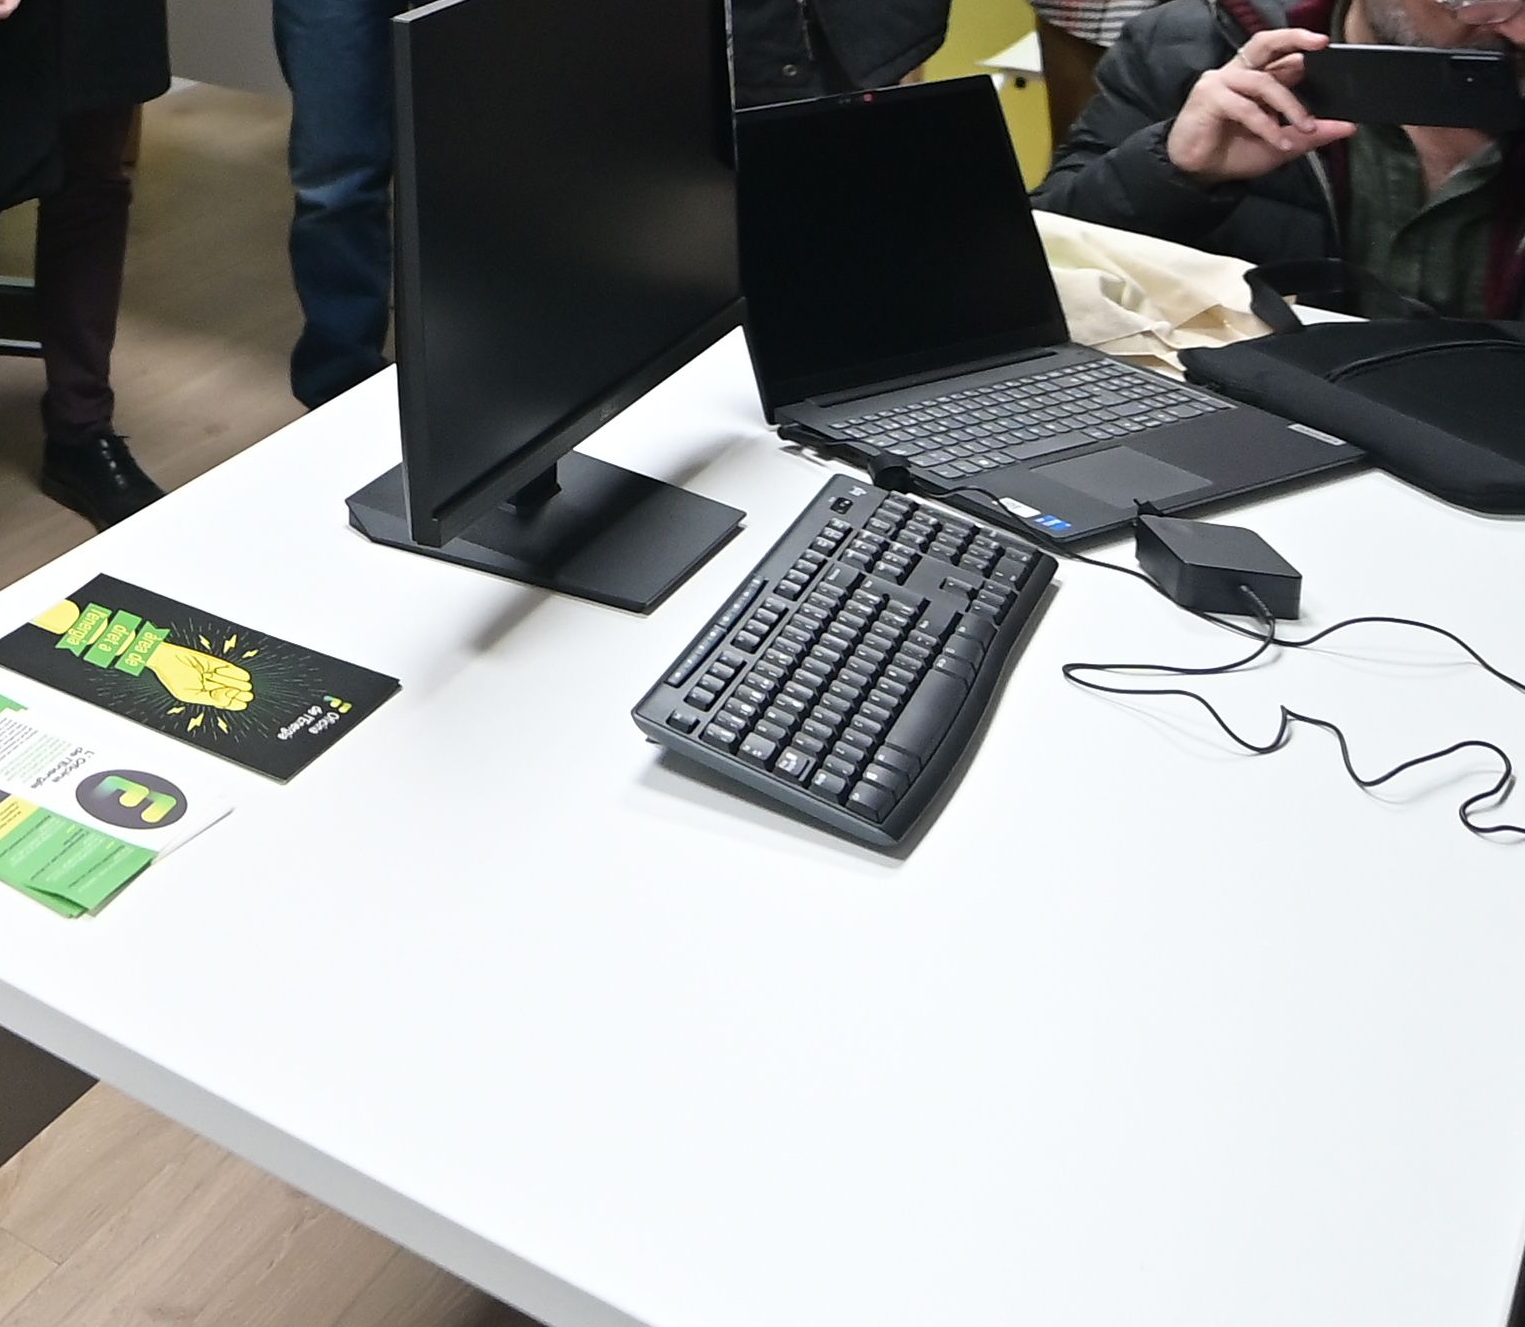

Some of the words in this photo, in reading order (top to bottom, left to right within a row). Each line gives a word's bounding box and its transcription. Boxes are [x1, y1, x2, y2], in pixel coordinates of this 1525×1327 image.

[107, 624, 129, 646] dret
[98, 643, 113, 652] a
[124, 652, 146, 667] de
